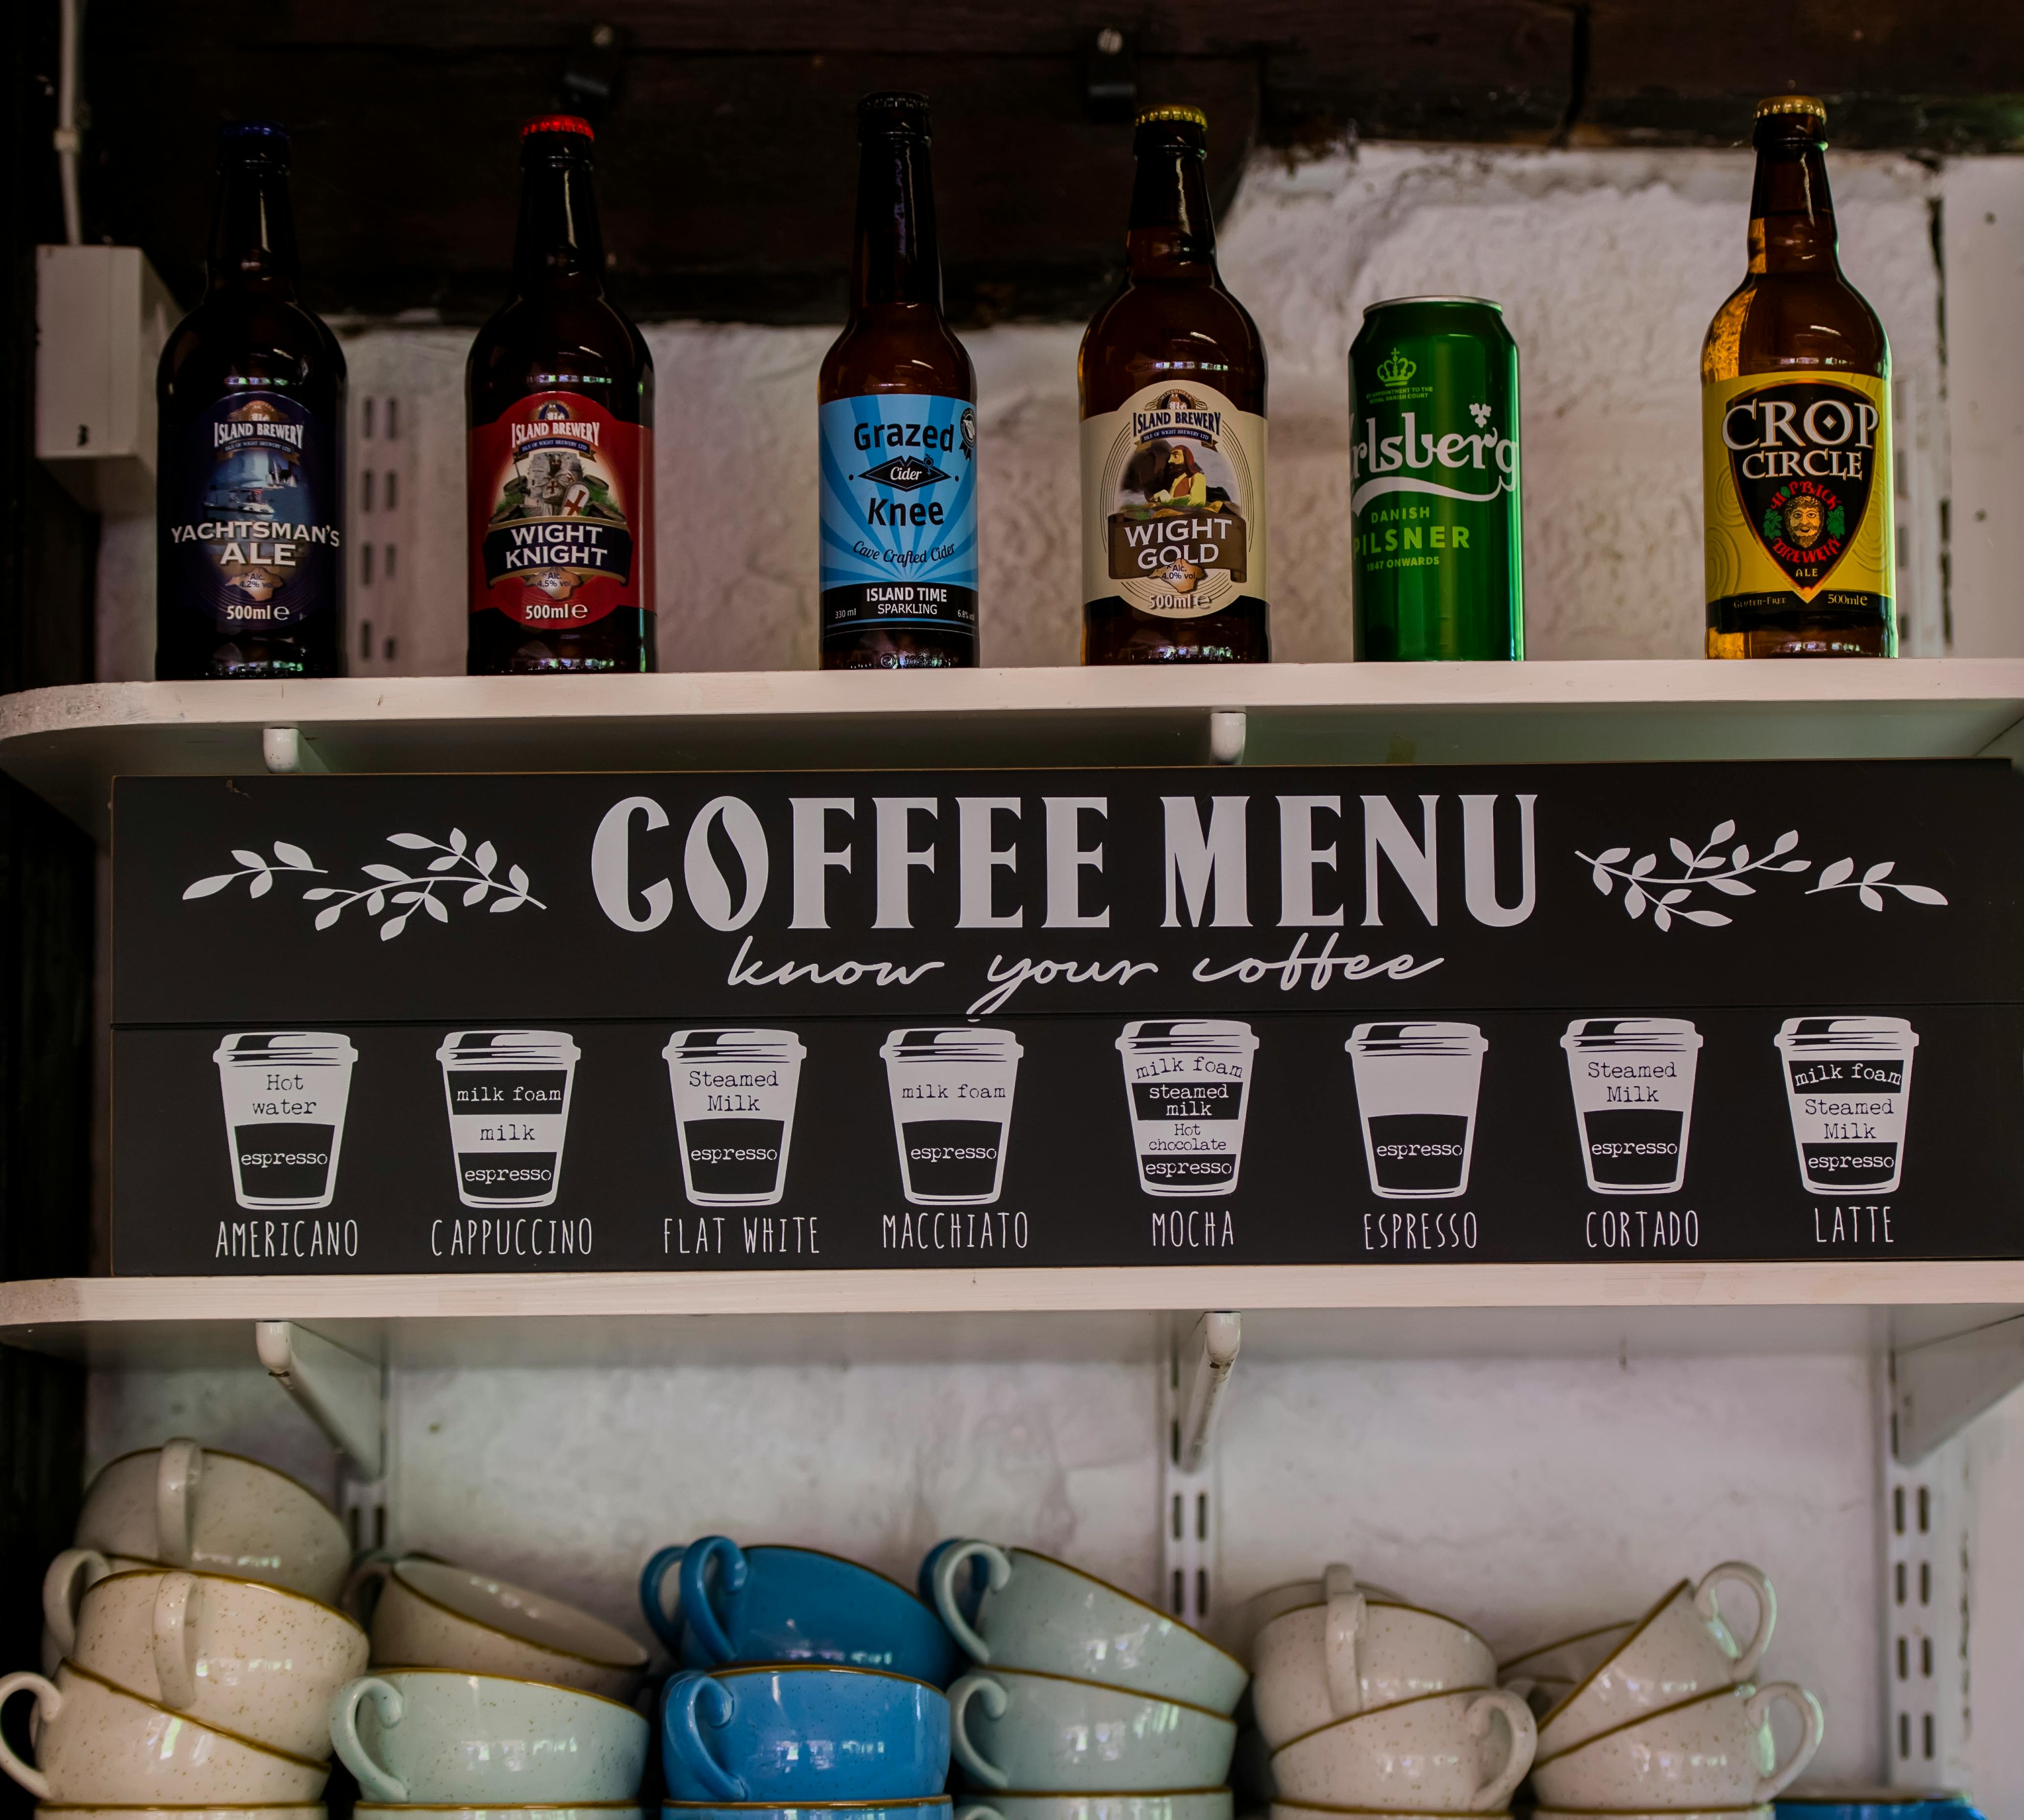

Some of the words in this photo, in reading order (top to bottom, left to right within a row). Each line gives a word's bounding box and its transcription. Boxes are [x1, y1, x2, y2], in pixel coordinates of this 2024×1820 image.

[1133, 412, 1171, 437] ISLAND
[1175, 412, 1220, 436] BREWERY
[1722, 398, 1879, 452] CROP
[214, 423, 253, 448] ISLAND
[257, 424, 304, 449] BREWERY
[512, 423, 549, 448] ISLAND
[553, 422, 599, 446] BREWERY
[854, 423, 955, 453] Grazed
[1350, 412, 1518, 492] rlsberg
[1742, 448, 1863, 480] CIRCLE
[890, 466, 922, 481] Cider
[867, 498, 944, 526] Knee
[1371, 506, 1430, 523] DANISH
[511, 525, 603, 546] WIGHT
[1124, 518, 1232, 547] WIGHT
[1353, 526, 1469, 559] PILSNER
[1773, 534, 1841, 563] BREWERY
[220, 543, 296, 566] ALE
[506, 545, 608, 569] KNIGHT
[853, 541, 880, 561] Cave
[883, 549, 927, 567] Crafted
[931, 543, 955, 562] Cider
[1138, 544, 1218, 570] GOLD
[1387, 556, 1439, 568] ONWARDS
[1796, 568, 1818, 577] ALE
[867, 587, 913, 602] ISLAND
[917, 588, 947, 602] TIME
[1148, 593, 1190, 608] 500ml
[1828, 594, 1859, 605] 500ml
[227, 605, 270, 619] 500ml
[526, 604, 568, 619] 500ml
[878, 604, 937, 614] SPARKLING
[591, 796, 1110, 932] COFFEE
[1160, 794, 1538, 928] MENU
[727, 935, 945, 986] know
[966, 952, 1159, 1022] your
[1192, 932, 1444, 991] coffee
[1136, 1057, 1185, 1079] milk
[1192, 1056, 1242, 1078] foam
[1588, 1062, 1677, 1079] Steamed
[1795, 1064, 1844, 1087] milk
[1851, 1063, 1901, 1086] foam
[266, 1074, 304, 1091] Hot
[689, 1070, 779, 1087] Steamed
[456, 1087, 505, 1102] milk
[512, 1086, 561, 1101] foam
[902, 1084, 949, 1099] milk
[957, 1084, 1006, 1099] foam
[1149, 1084, 1229, 1099] steamed
[1606, 1086, 1659, 1103] Milk
[252, 1099, 317, 1115] water
[707, 1094, 760, 1112] Milk
[1165, 1101, 1213, 1116] milk
[1805, 1098, 1894, 1115] Steamed
[480, 1124, 535, 1141] milk
[1174, 1123, 1201, 1136] Hot
[1824, 1122, 1877, 1139] Milk
[1149, 1138, 1226, 1151] chocolate
[1376, 1144, 1463, 1160] espresso
[1592, 1142, 1678, 1158] espresso
[241, 1153, 328, 1168] espresso
[691, 1149, 777, 1164] espresso
[911, 1147, 997, 1163] espresso
[1808, 1156, 1894, 1171] espresso
[464, 1169, 552, 1185] espresso
[1145, 1163, 1232, 1178] espresso
[883, 1212, 1028, 1249] MACCHIATO
[1152, 1210, 1234, 1247] MOCHA
[1364, 1212, 1477, 1250] ESPRESSO
[1586, 1210, 1698, 1248] CORTADO
[1815, 1206, 1894, 1243] LATTE
[215, 1219, 357, 1258] AMERICANO
[431, 1217, 592, 1256] CAPPUCCINO
[664, 1217, 725, 1254] FLAT
[743, 1216, 820, 1254] WHITE
